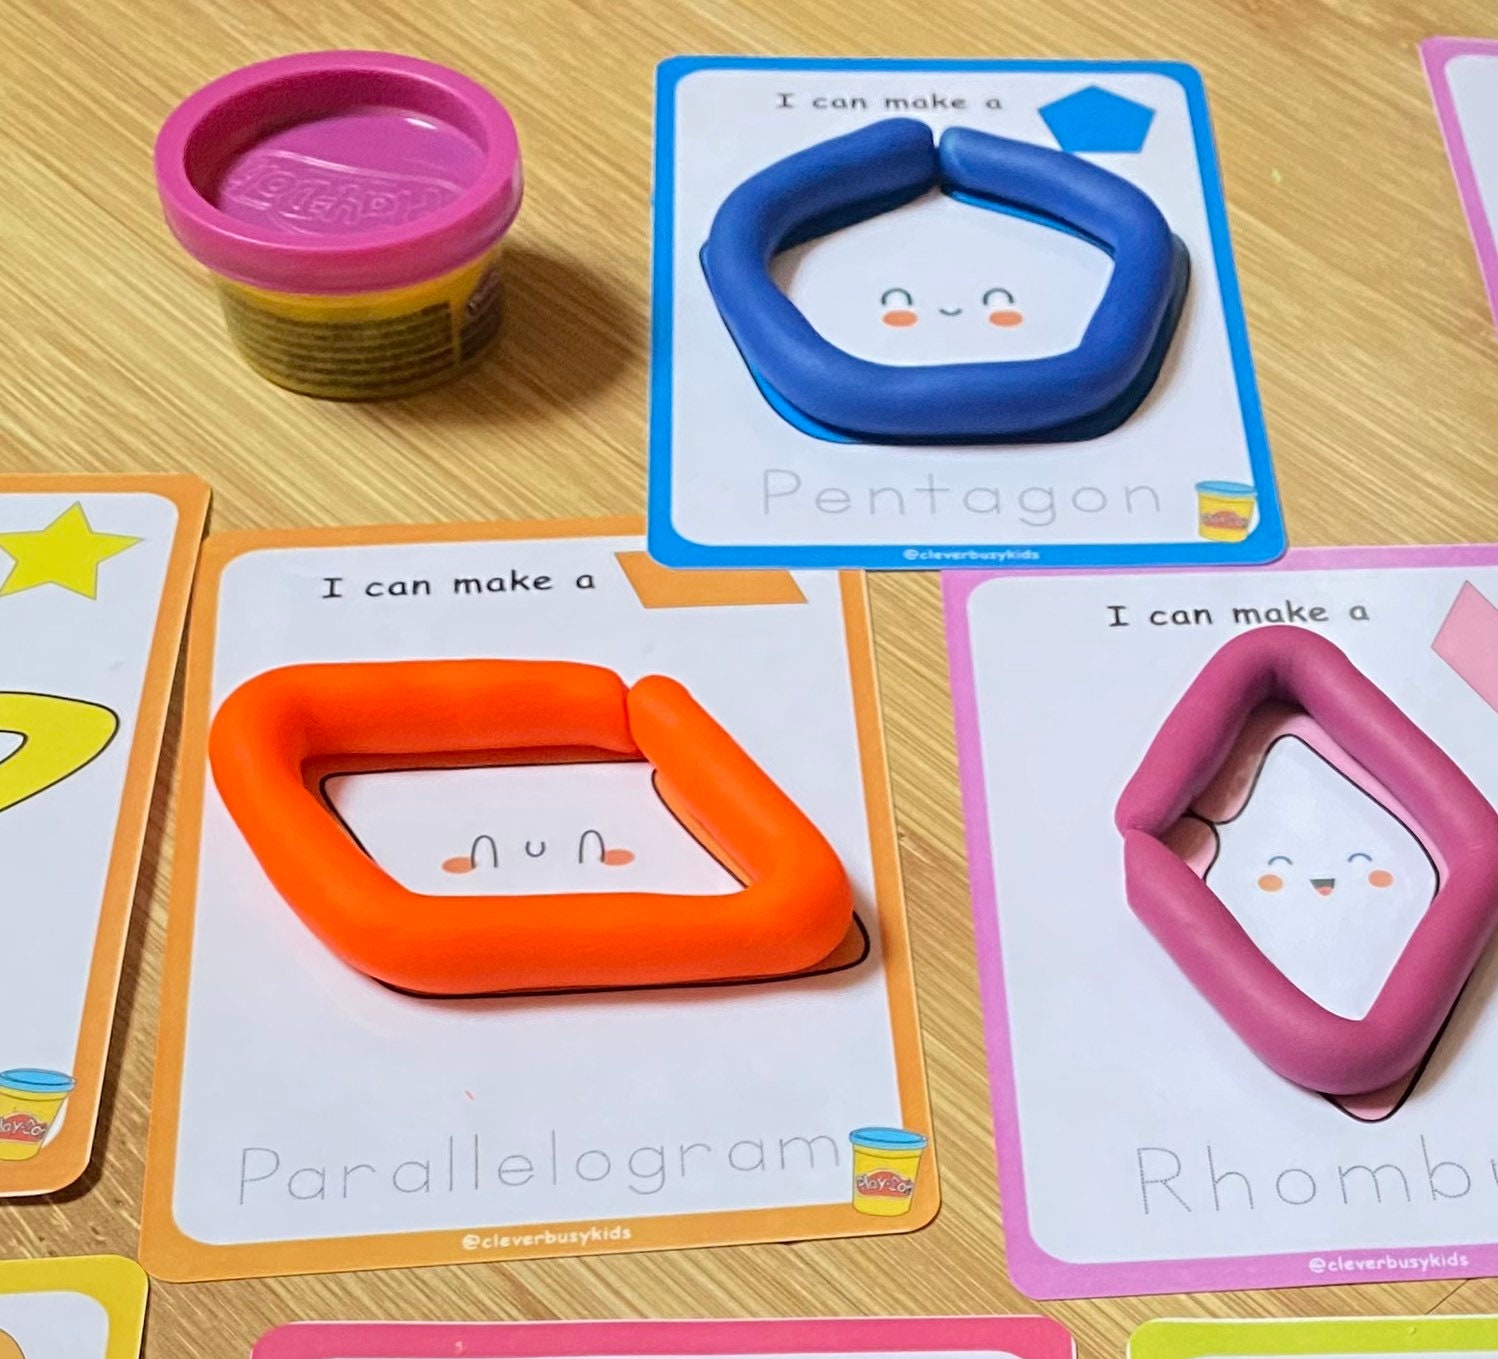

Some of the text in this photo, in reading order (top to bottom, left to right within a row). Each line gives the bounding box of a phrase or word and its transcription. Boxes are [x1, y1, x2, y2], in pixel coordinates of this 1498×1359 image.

[778, 92, 1003, 111] I can make a
[762, 468, 1161, 528] Pentagon
[902, 548, 1041, 562] @cleverbusykids
[321, 568, 596, 600] I can make a
[1106, 599, 1371, 628] I can make a
[238, 1128, 841, 1208] Parallelogram
[460, 1227, 635, 1253] @cleverbusykids
[1308, 1251, 1470, 1274] @cleverbusykids
